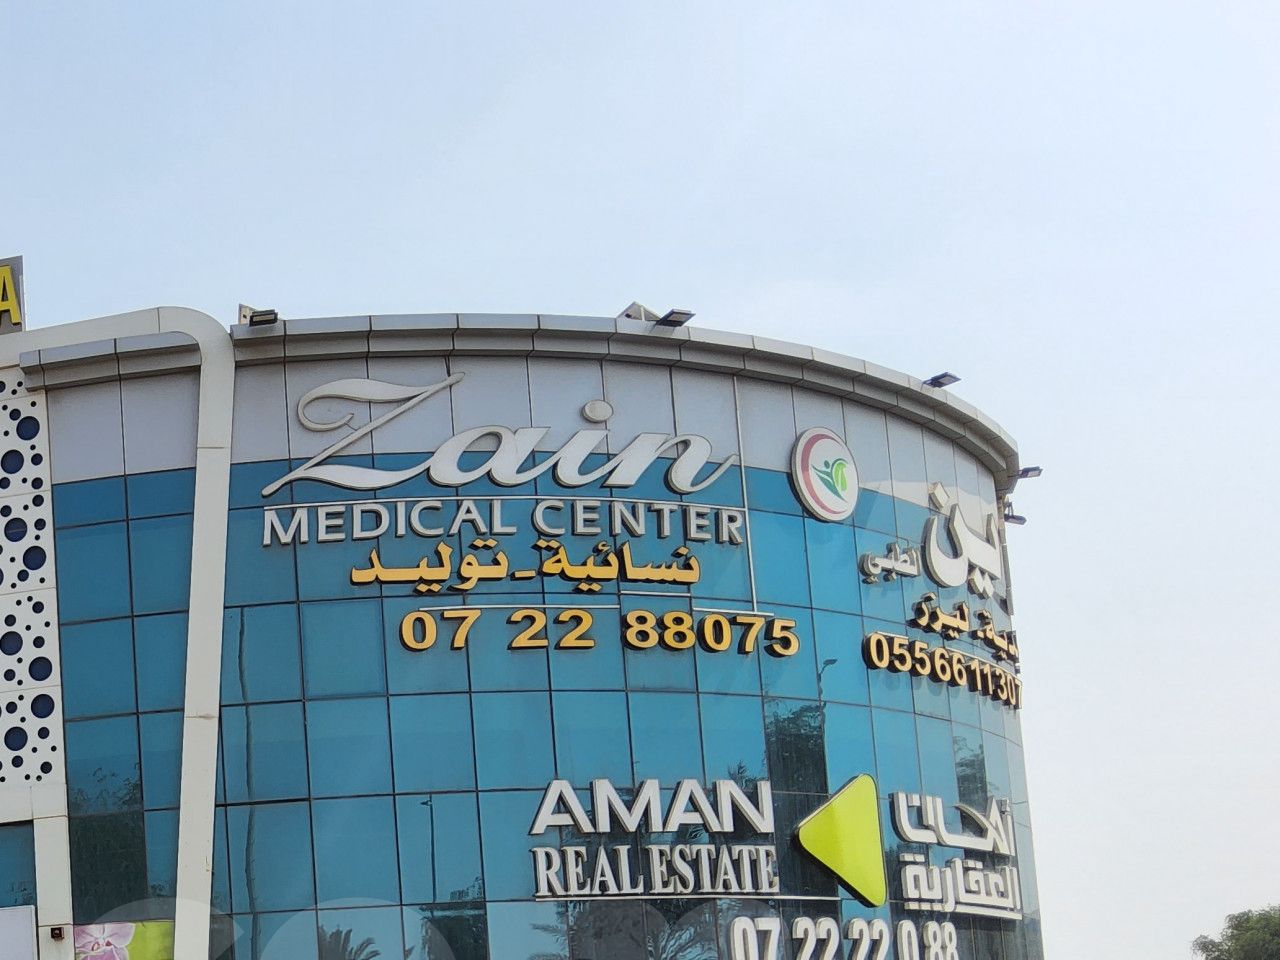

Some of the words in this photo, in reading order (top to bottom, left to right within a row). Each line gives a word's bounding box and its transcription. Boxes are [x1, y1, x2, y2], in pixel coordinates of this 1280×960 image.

[261, 371, 738, 497] Zain
[262, 500, 517, 546] MEDICAL
[533, 500, 745, 545] CENTER
[401, 608, 482, 652] 07
[507, 607, 597, 650] 22
[624, 609, 801, 657] 88075
[863, 632, 1023, 709] 0556611307
[529, 778, 775, 835] AMAN
[532, 844, 644, 897] REAL
[646, 843, 781, 895] ESTATE
